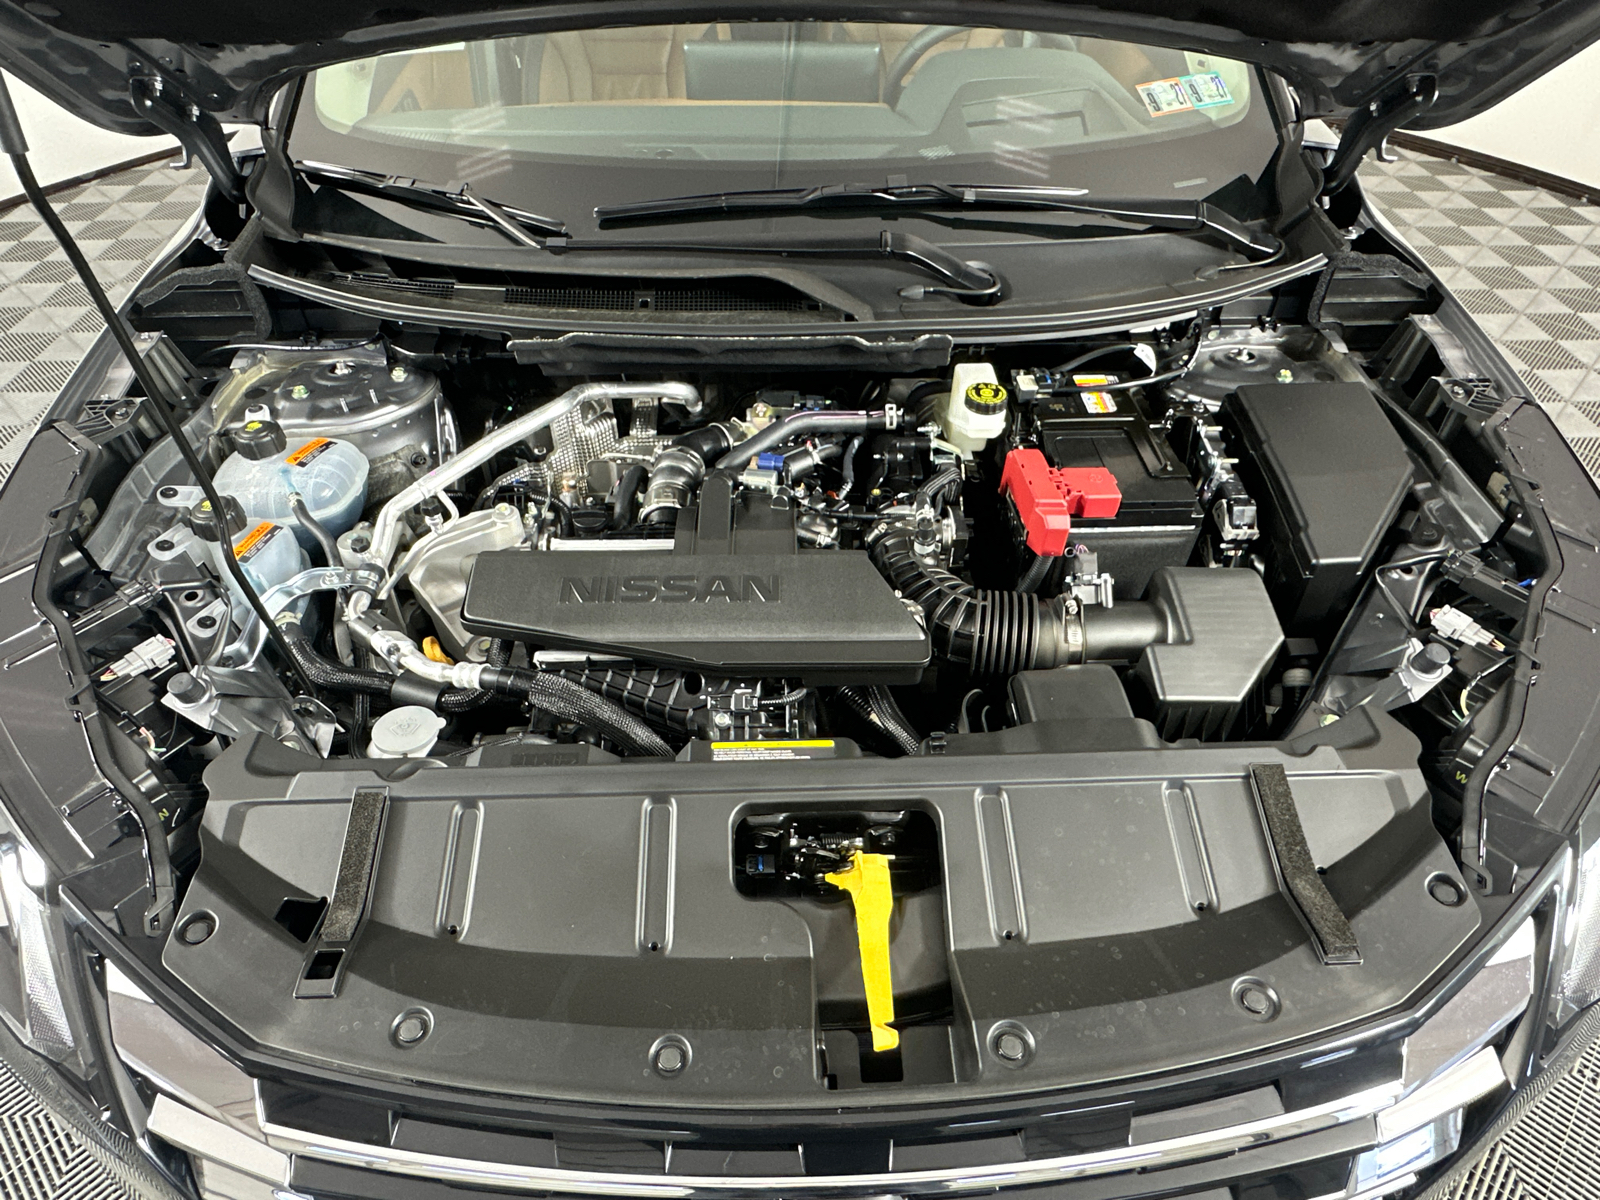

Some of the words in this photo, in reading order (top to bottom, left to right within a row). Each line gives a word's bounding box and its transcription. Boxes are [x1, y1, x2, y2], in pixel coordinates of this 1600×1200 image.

[1146, 92, 1161, 112] 9
[1169, 82, 1188, 105] 27
[1189, 84, 1203, 102] 9
[1210, 76, 1227, 98] 27
[557, 573, 782, 605] NISSAN
